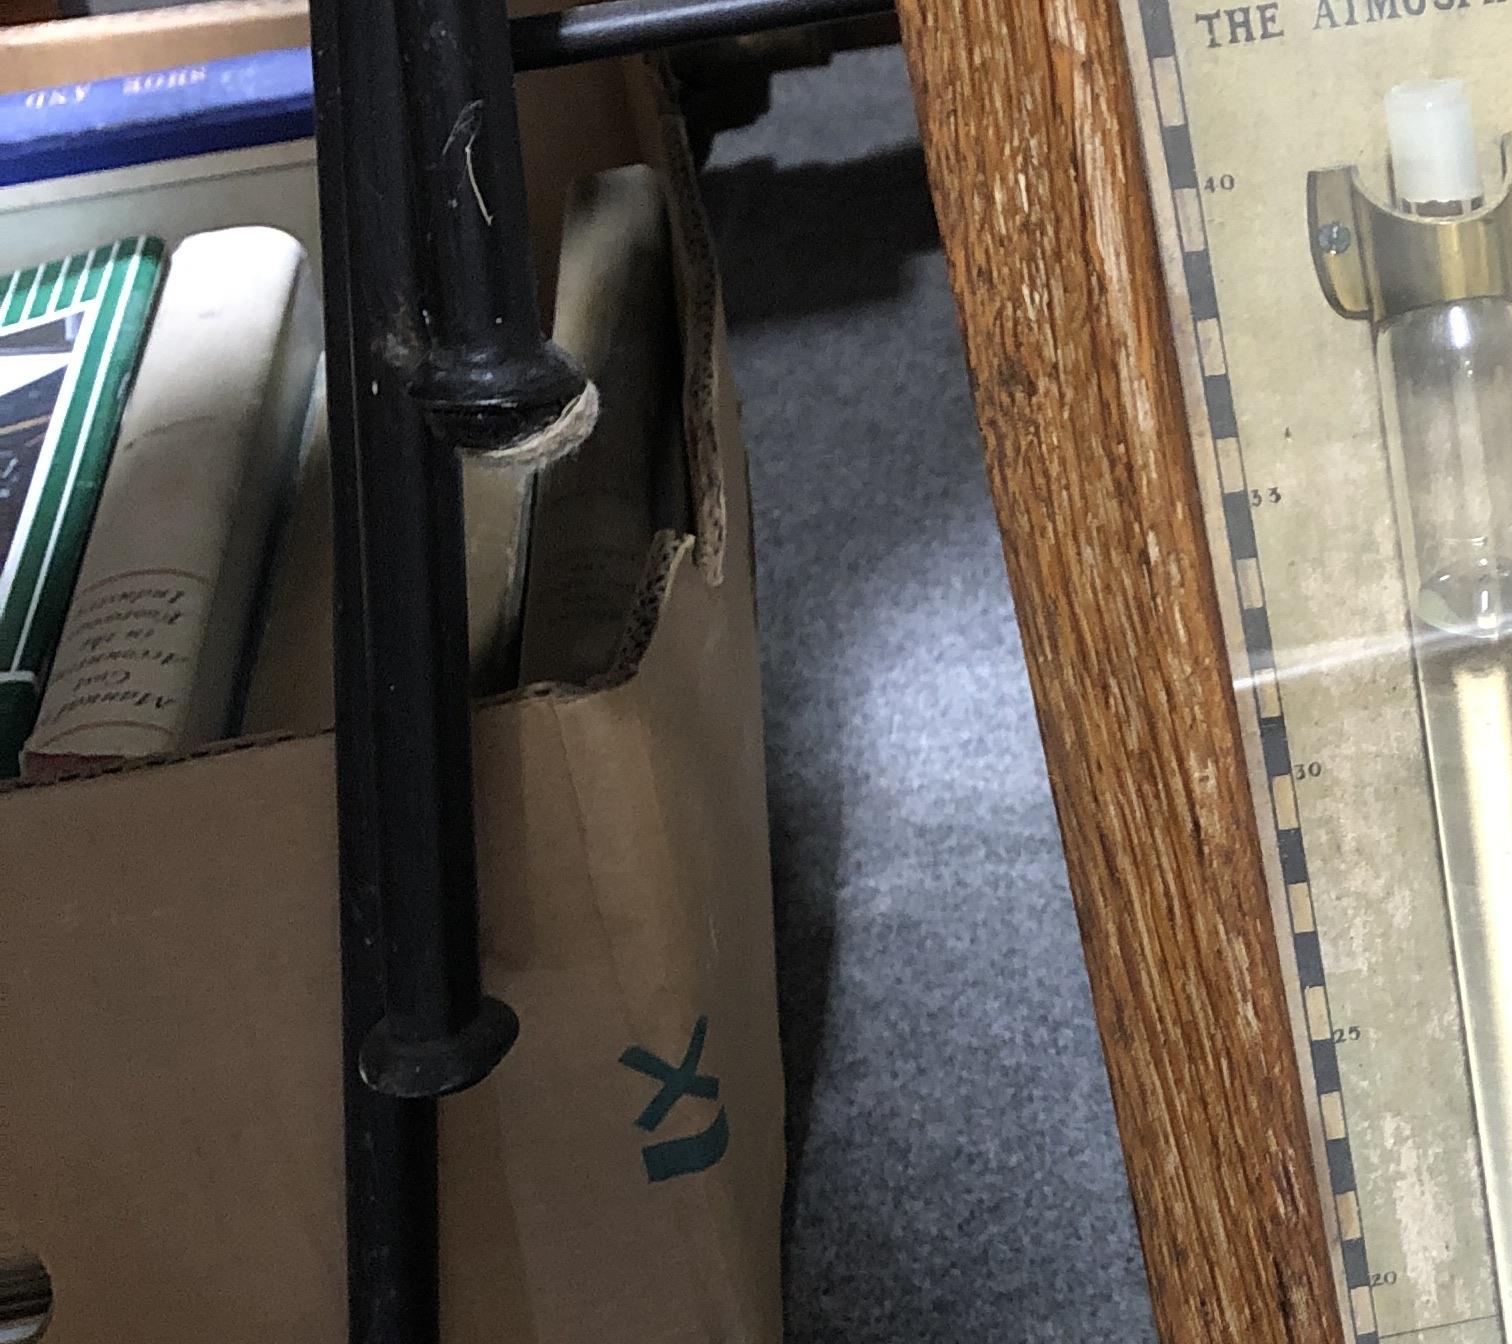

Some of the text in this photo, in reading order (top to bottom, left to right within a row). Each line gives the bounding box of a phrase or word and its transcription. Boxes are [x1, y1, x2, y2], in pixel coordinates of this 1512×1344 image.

[1195, 2, 1285, 49] THE
[1203, 174, 1235, 193] 40
[1294, 761, 1322, 781] 30
[1332, 1025, 1361, 1045] 25
[1370, 1270, 1397, 1288] 20
